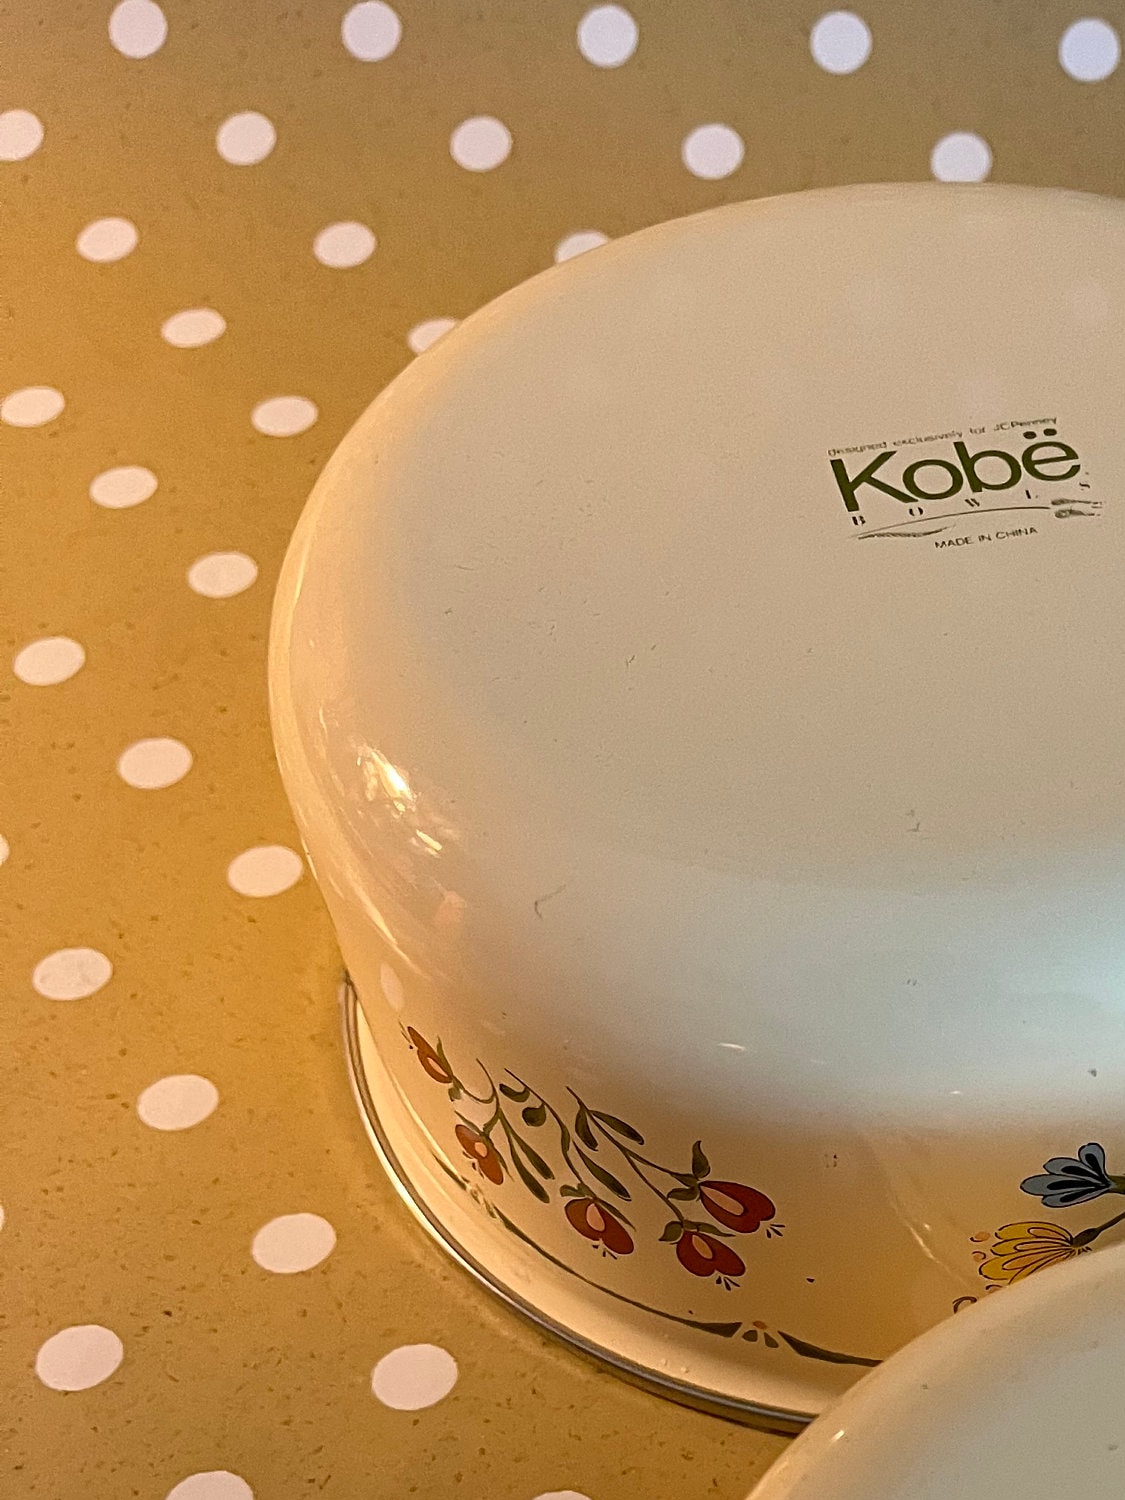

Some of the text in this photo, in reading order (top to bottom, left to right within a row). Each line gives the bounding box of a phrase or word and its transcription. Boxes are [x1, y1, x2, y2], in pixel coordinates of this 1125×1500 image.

[830, 430, 1081, 513] Kobë
[934, 526, 1039, 550] MADE IN CHINA
